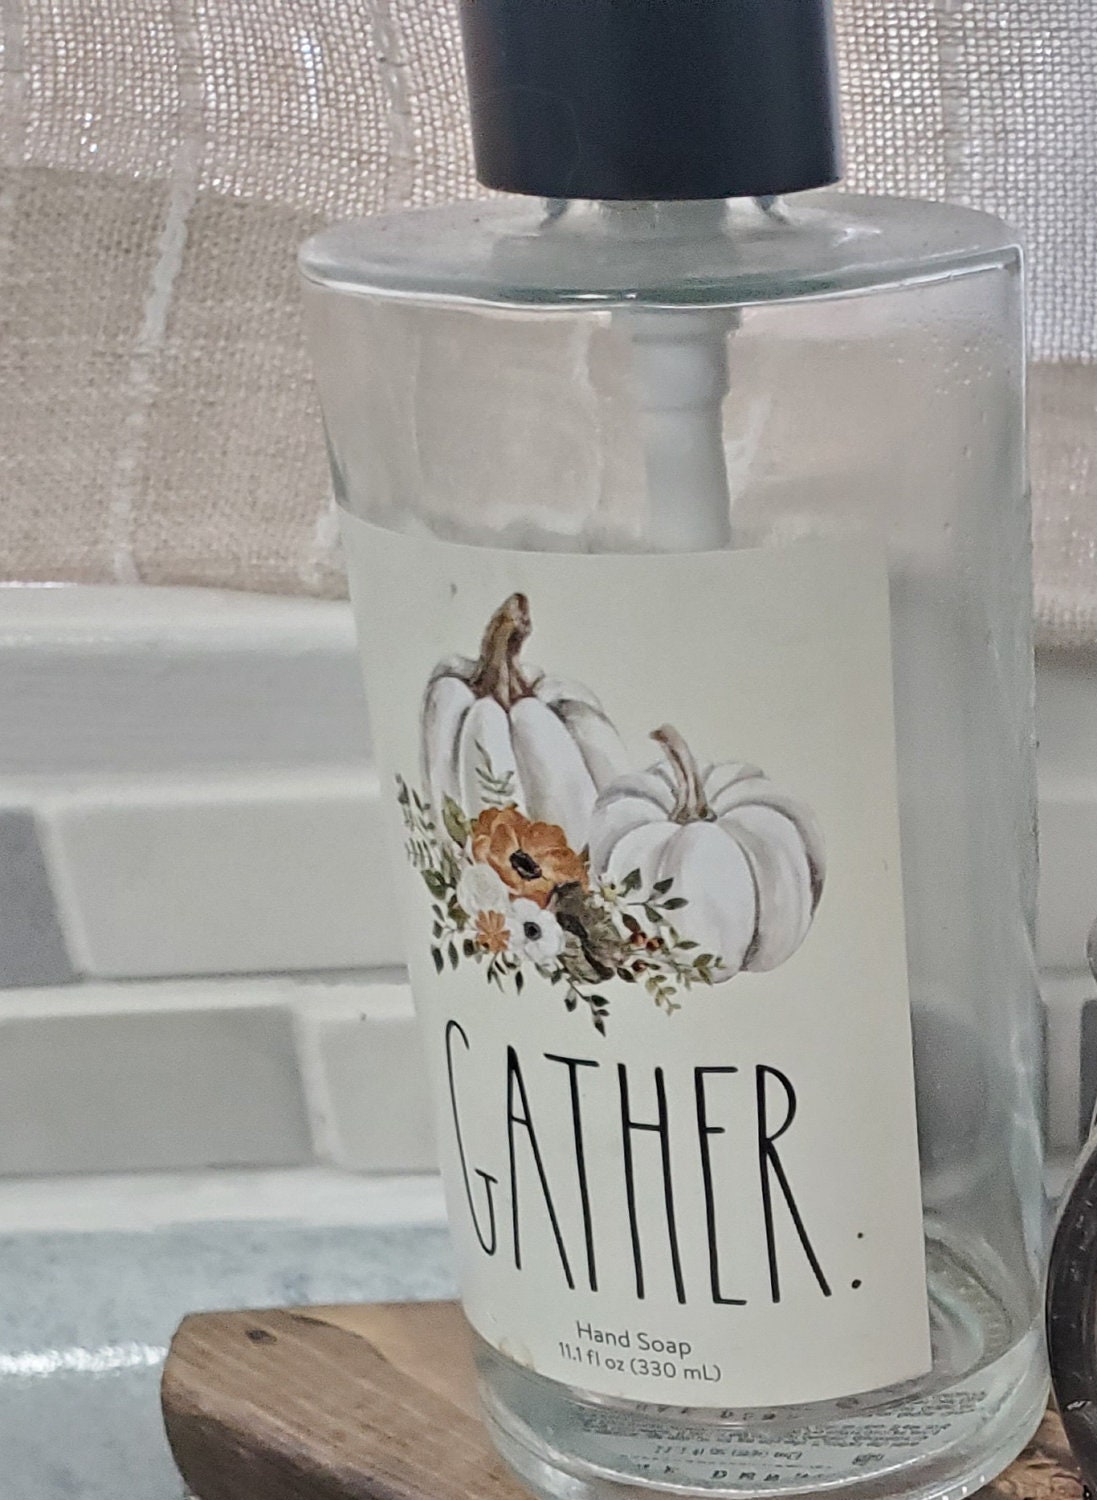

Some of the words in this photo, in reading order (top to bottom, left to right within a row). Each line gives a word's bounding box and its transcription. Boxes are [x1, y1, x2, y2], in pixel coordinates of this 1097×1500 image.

[575, 1320, 631, 1348] Hand
[636, 1332, 692, 1360] Soap
[558, 1341, 583, 1363] 11.1
[586, 1349, 601, 1367] fl
[605, 1357, 626, 1372] oz
[630, 1357, 677, 1379] (330
[683, 1364, 722, 1383] mL)
